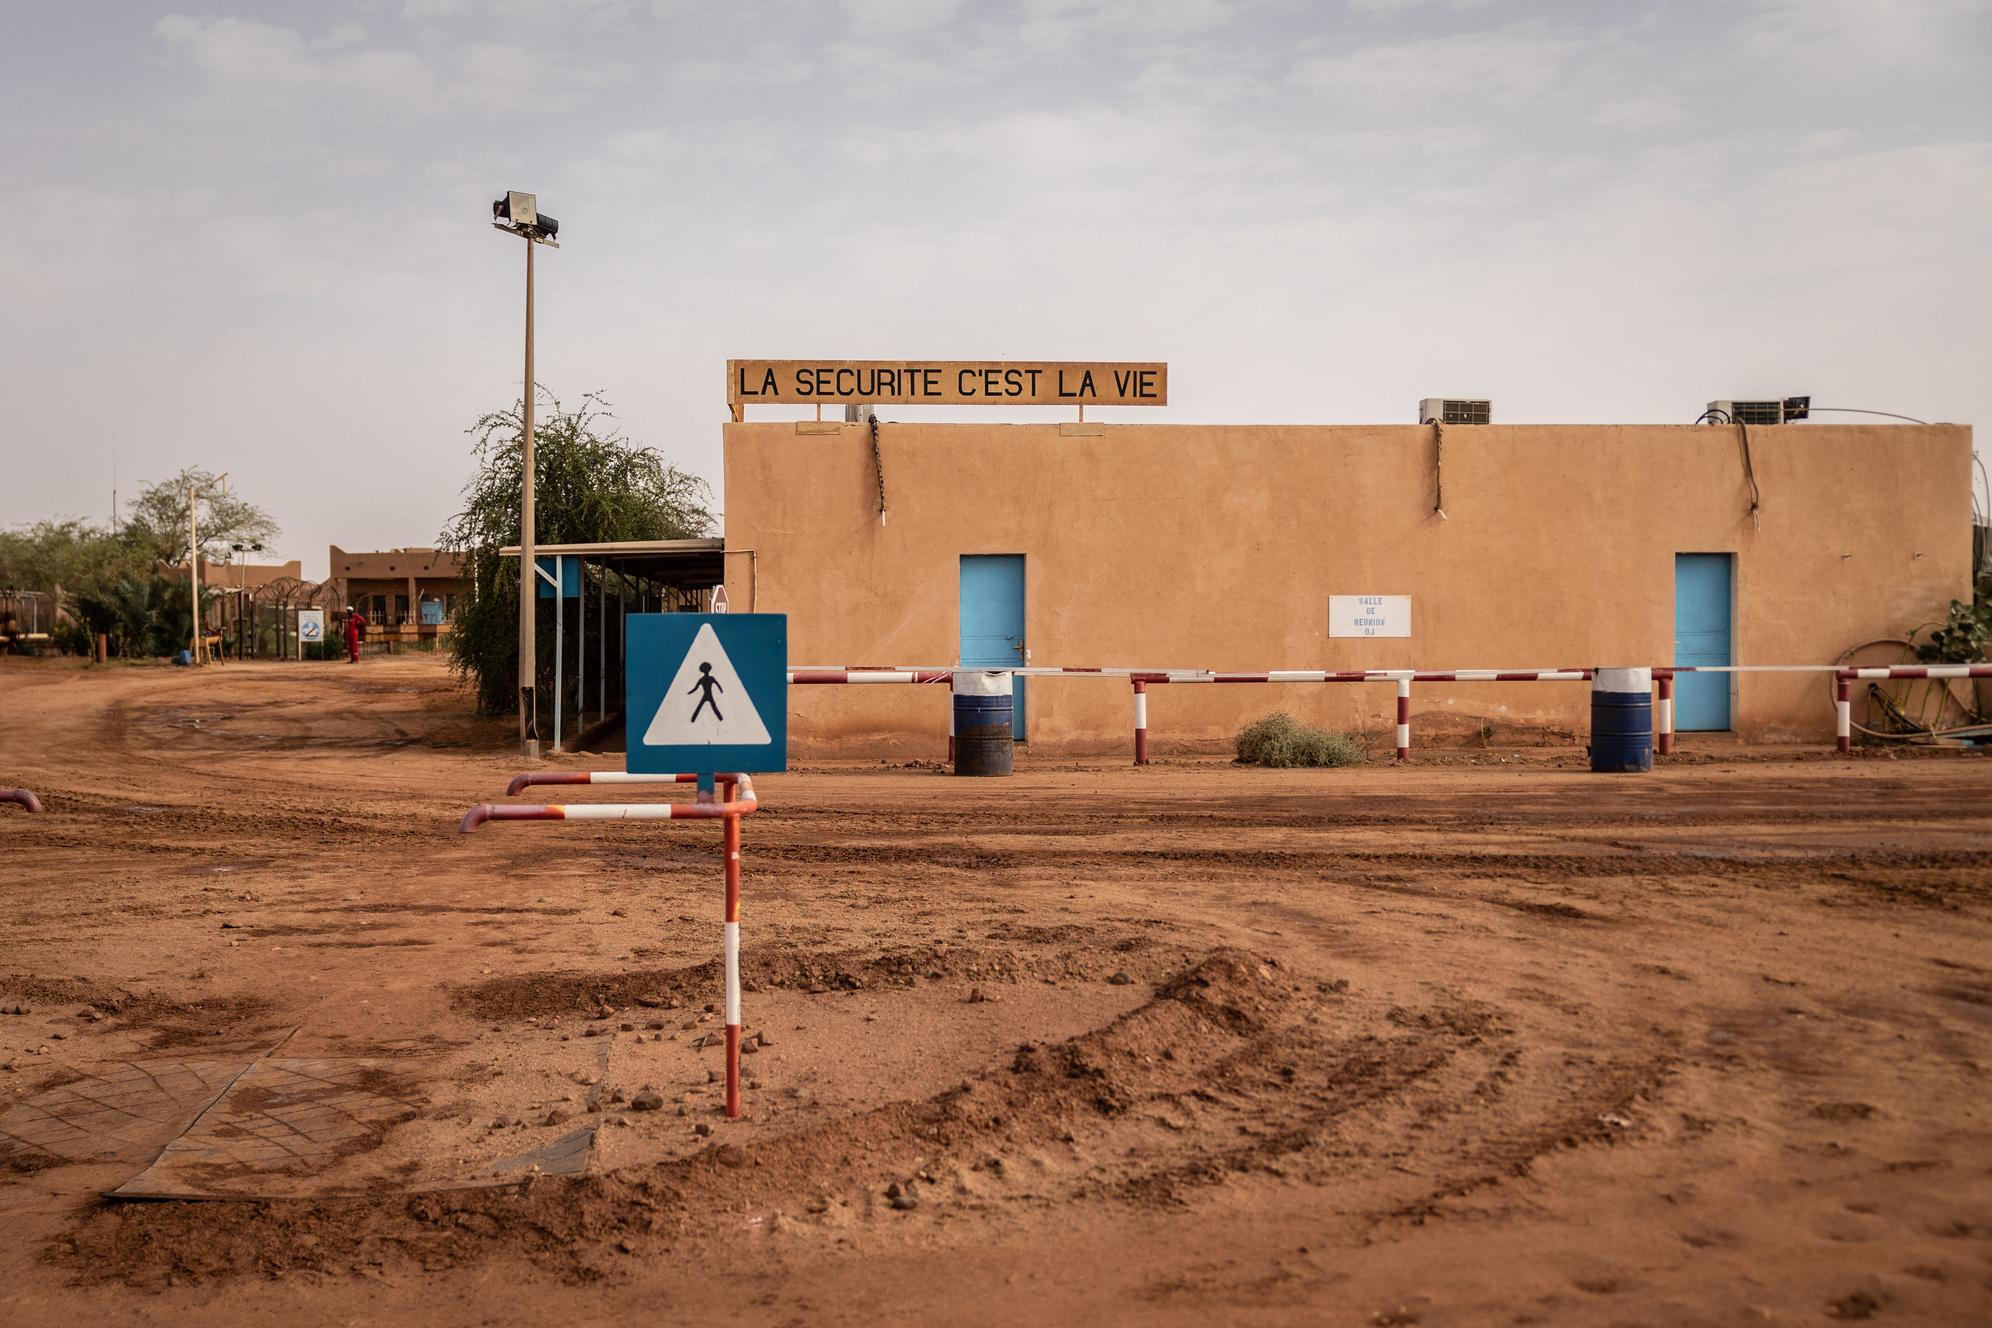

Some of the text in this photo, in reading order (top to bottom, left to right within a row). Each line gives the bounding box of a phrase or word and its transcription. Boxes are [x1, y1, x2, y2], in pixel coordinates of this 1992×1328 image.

[740, 368, 1158, 398] LA SECURITE C'EST LA VIE
[1359, 597, 1384, 606] SALLE
[1366, 607, 1376, 615] DE
